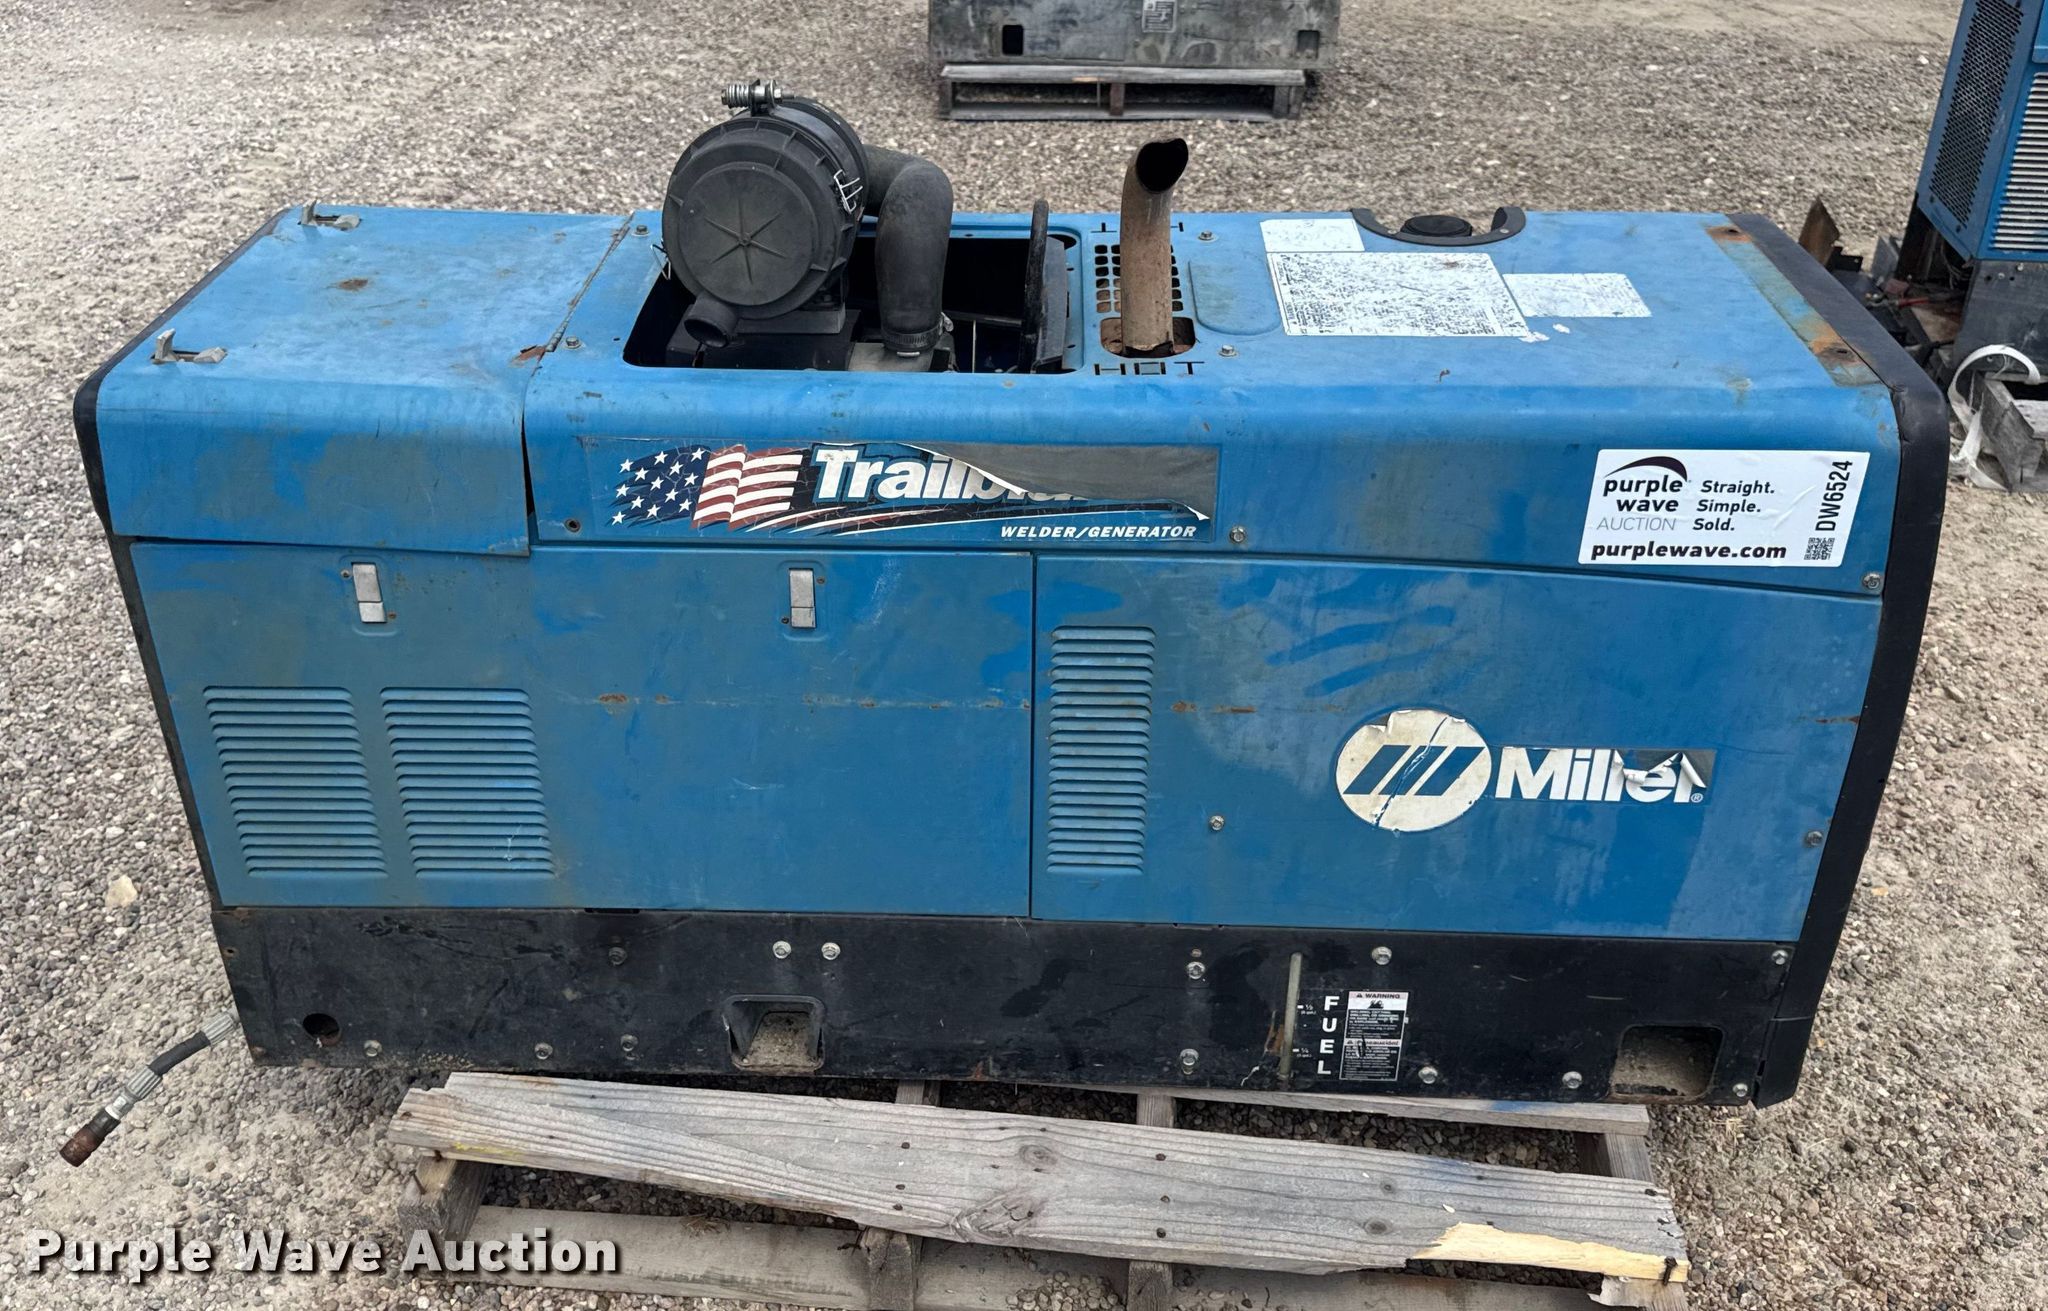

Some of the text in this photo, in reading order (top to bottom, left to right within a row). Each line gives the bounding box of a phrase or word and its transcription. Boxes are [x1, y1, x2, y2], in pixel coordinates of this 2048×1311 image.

[1094, 362, 1205, 375] HOT
[1603, 475, 1683, 497] purple
[1700, 480, 1775, 497] Straight.
[1815, 460, 1853, 531] DW6524
[1616, 499, 1679, 512] wave
[1696, 499, 1761, 515] Simple.
[1596, 517, 1677, 531] AUCTION
[1692, 518, 1735, 531] Sold.
[1001, 526, 1197, 539] WELDER/GENERATOR
[1591, 541, 1787, 561] purplewave.com
